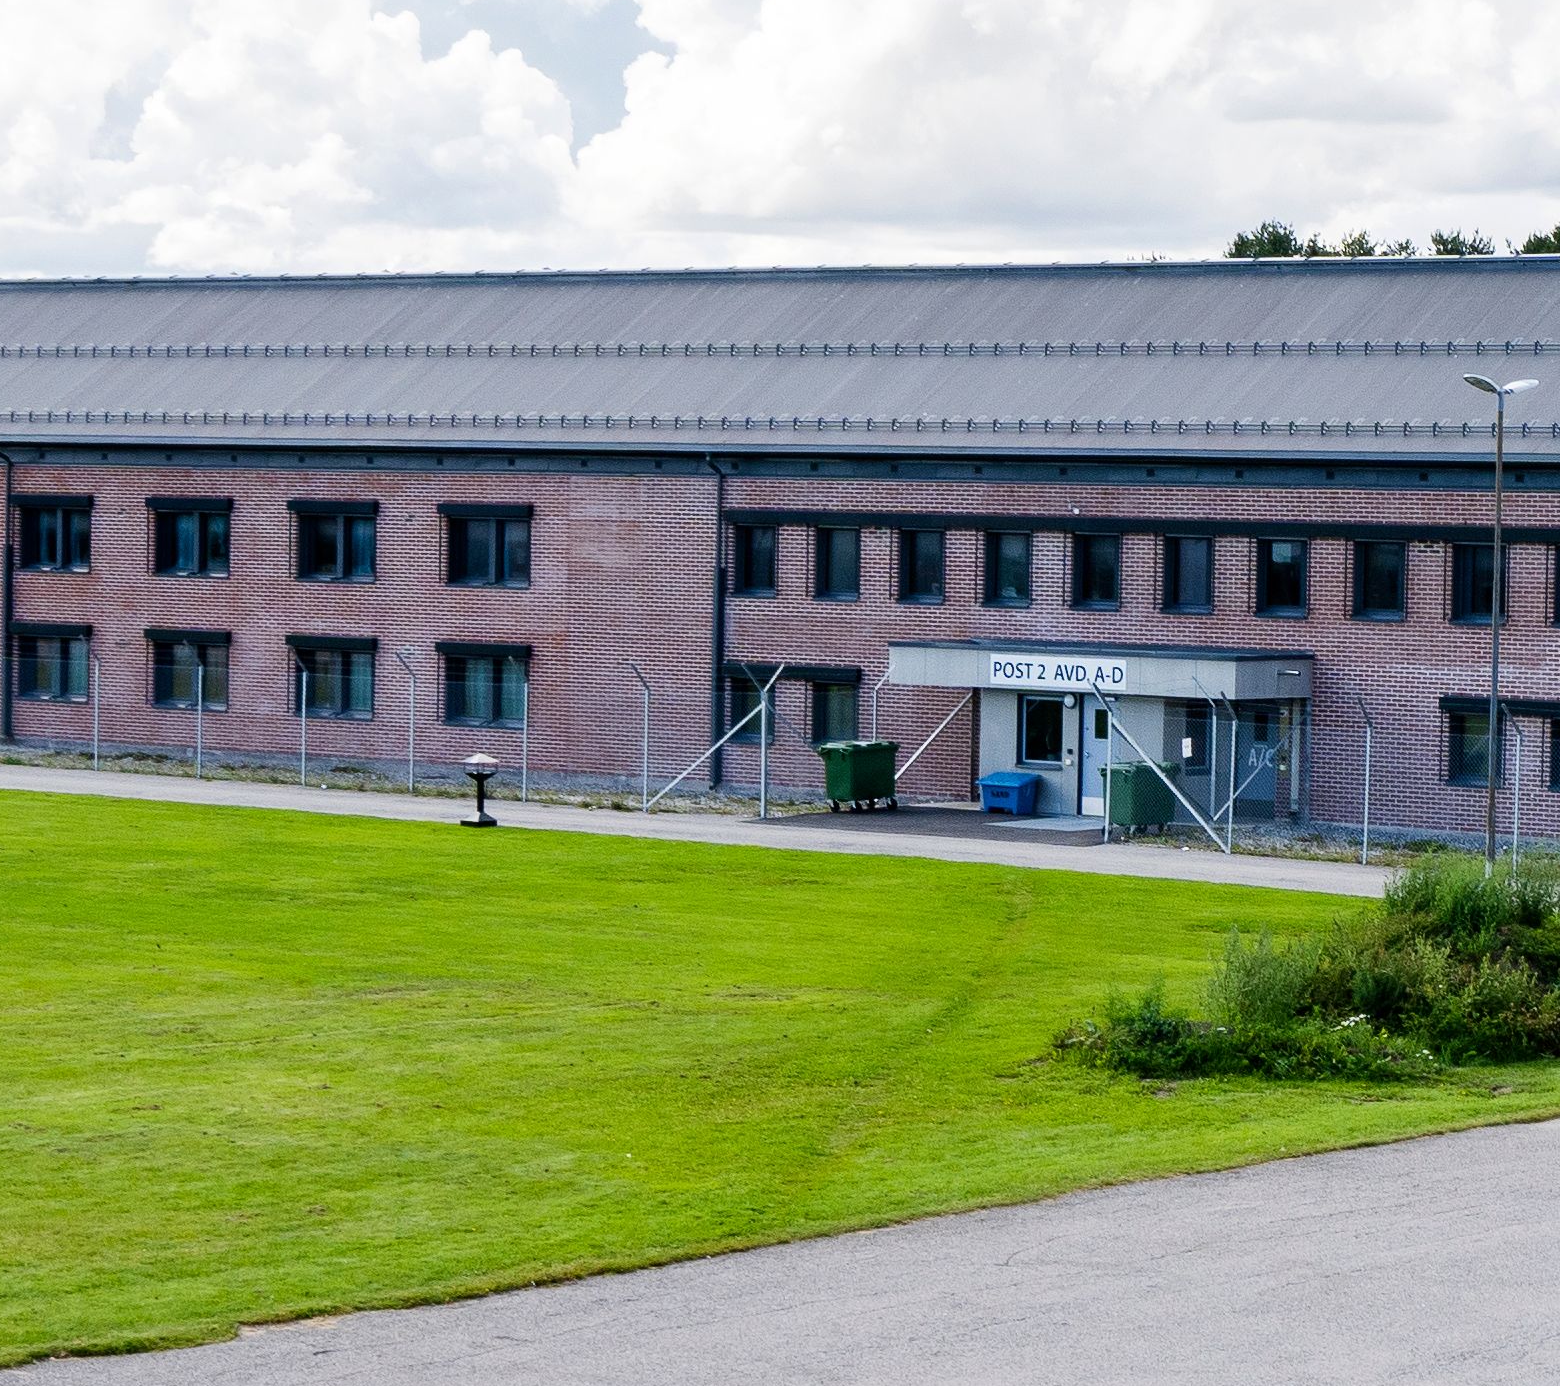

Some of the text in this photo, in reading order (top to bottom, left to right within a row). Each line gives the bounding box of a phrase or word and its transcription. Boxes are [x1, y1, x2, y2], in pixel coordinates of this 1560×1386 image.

[993, 661, 1033, 680] POST
[1037, 664, 1046, 680] 2
[1094, 666, 1124, 684] A-D
